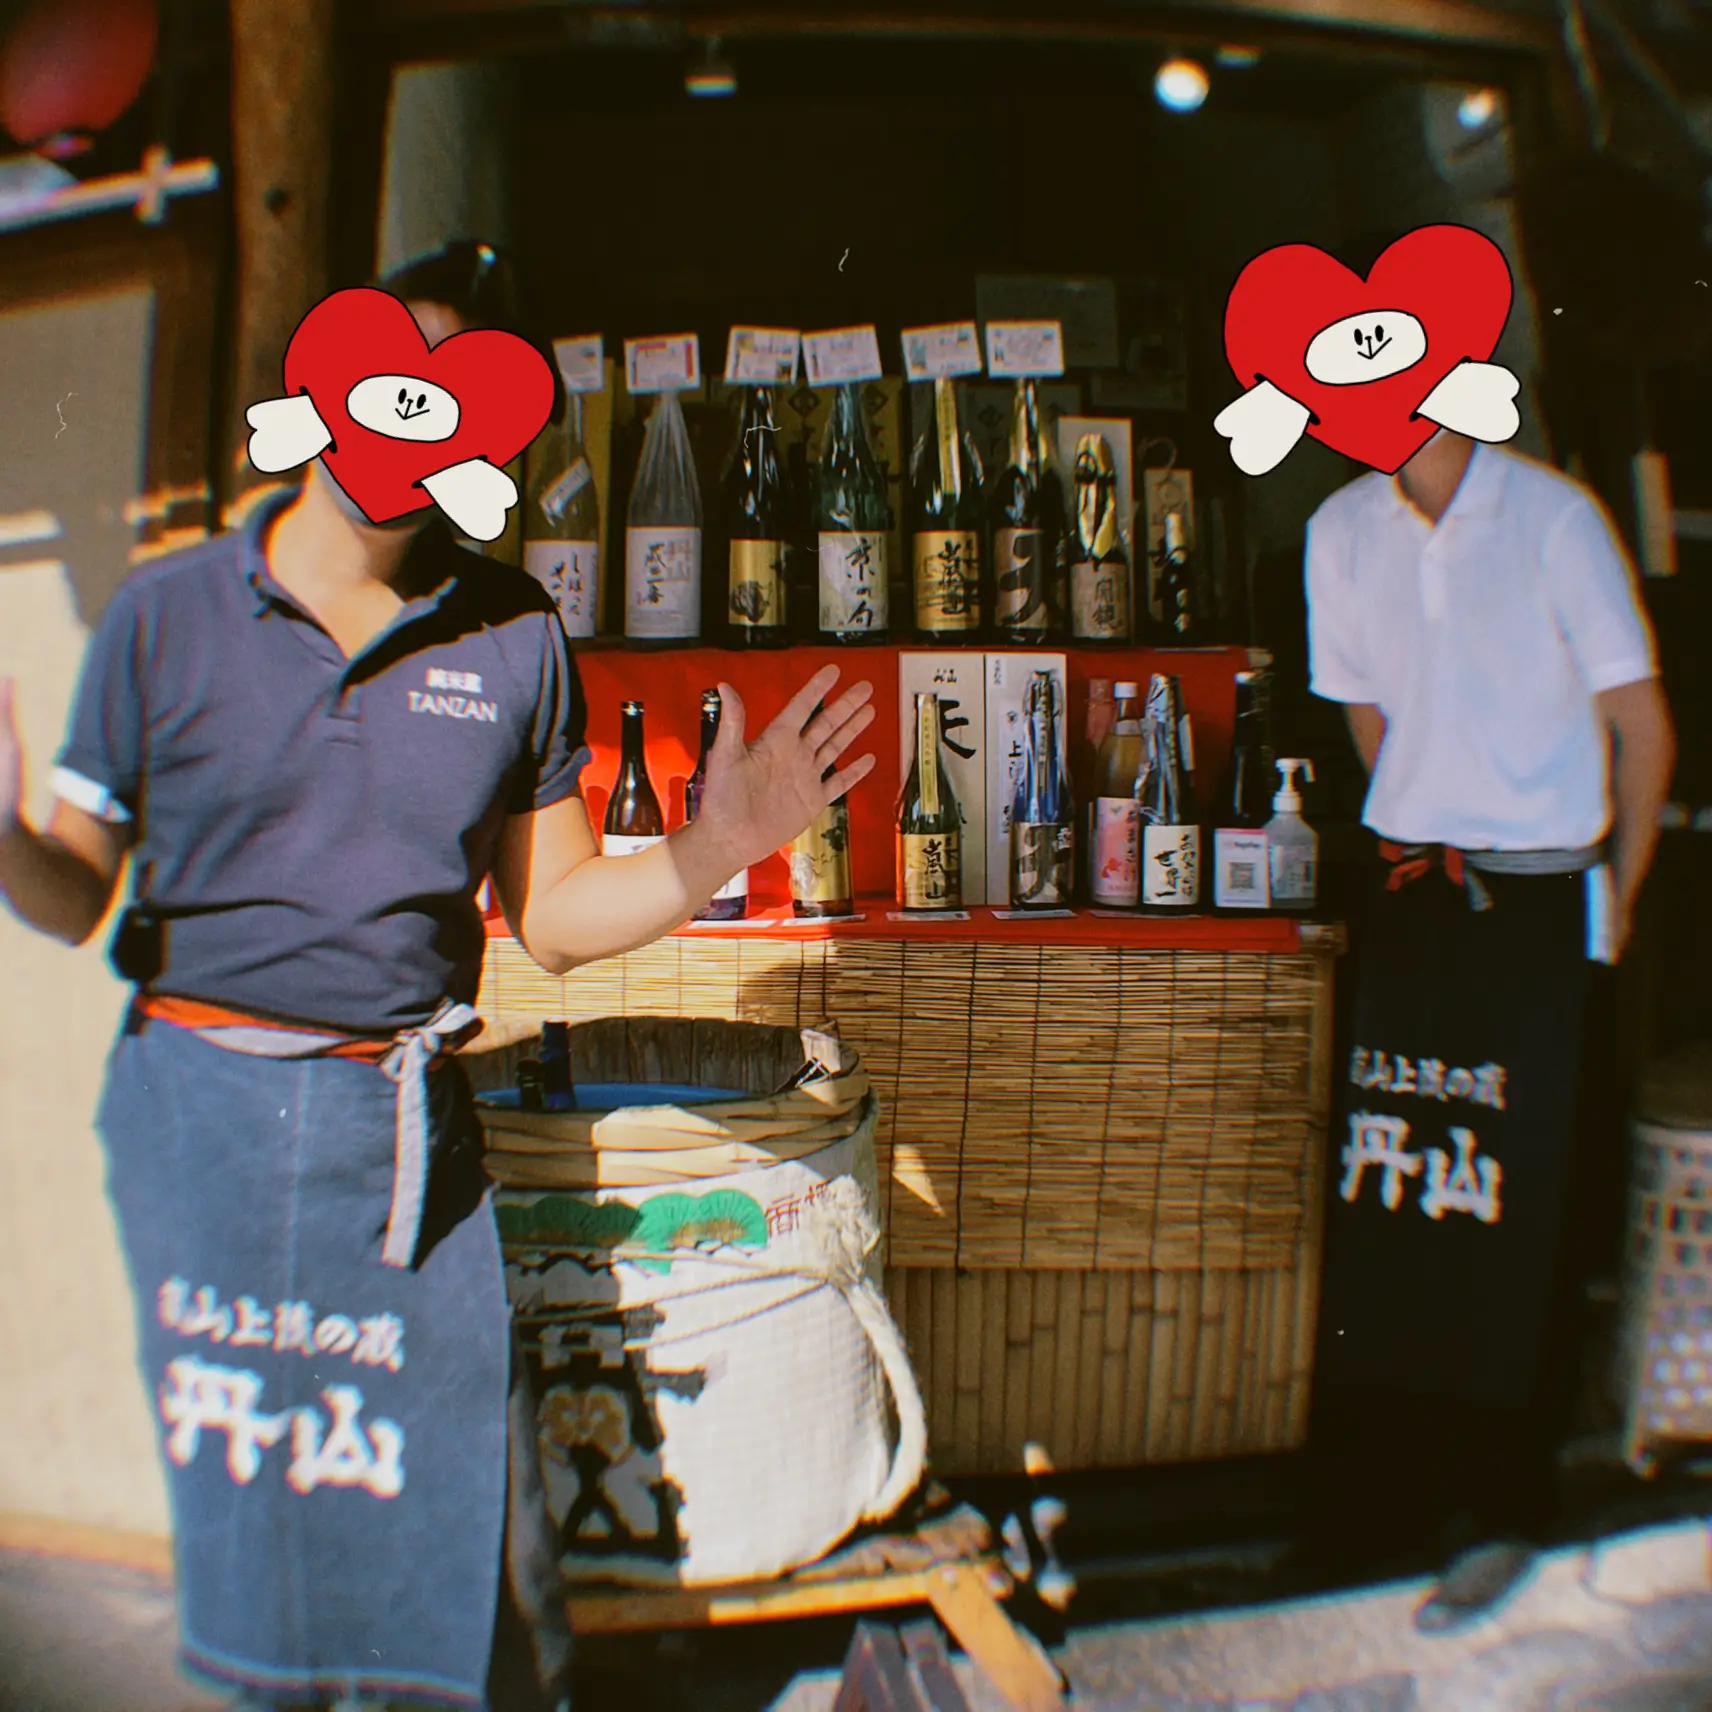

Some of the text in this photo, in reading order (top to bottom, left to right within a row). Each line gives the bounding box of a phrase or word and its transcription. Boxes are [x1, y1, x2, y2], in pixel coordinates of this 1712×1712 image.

[407, 689, 498, 723] TANZAN
[1339, 1110, 1502, 1225] 丹山
[160, 1353, 405, 1499] 丹山
